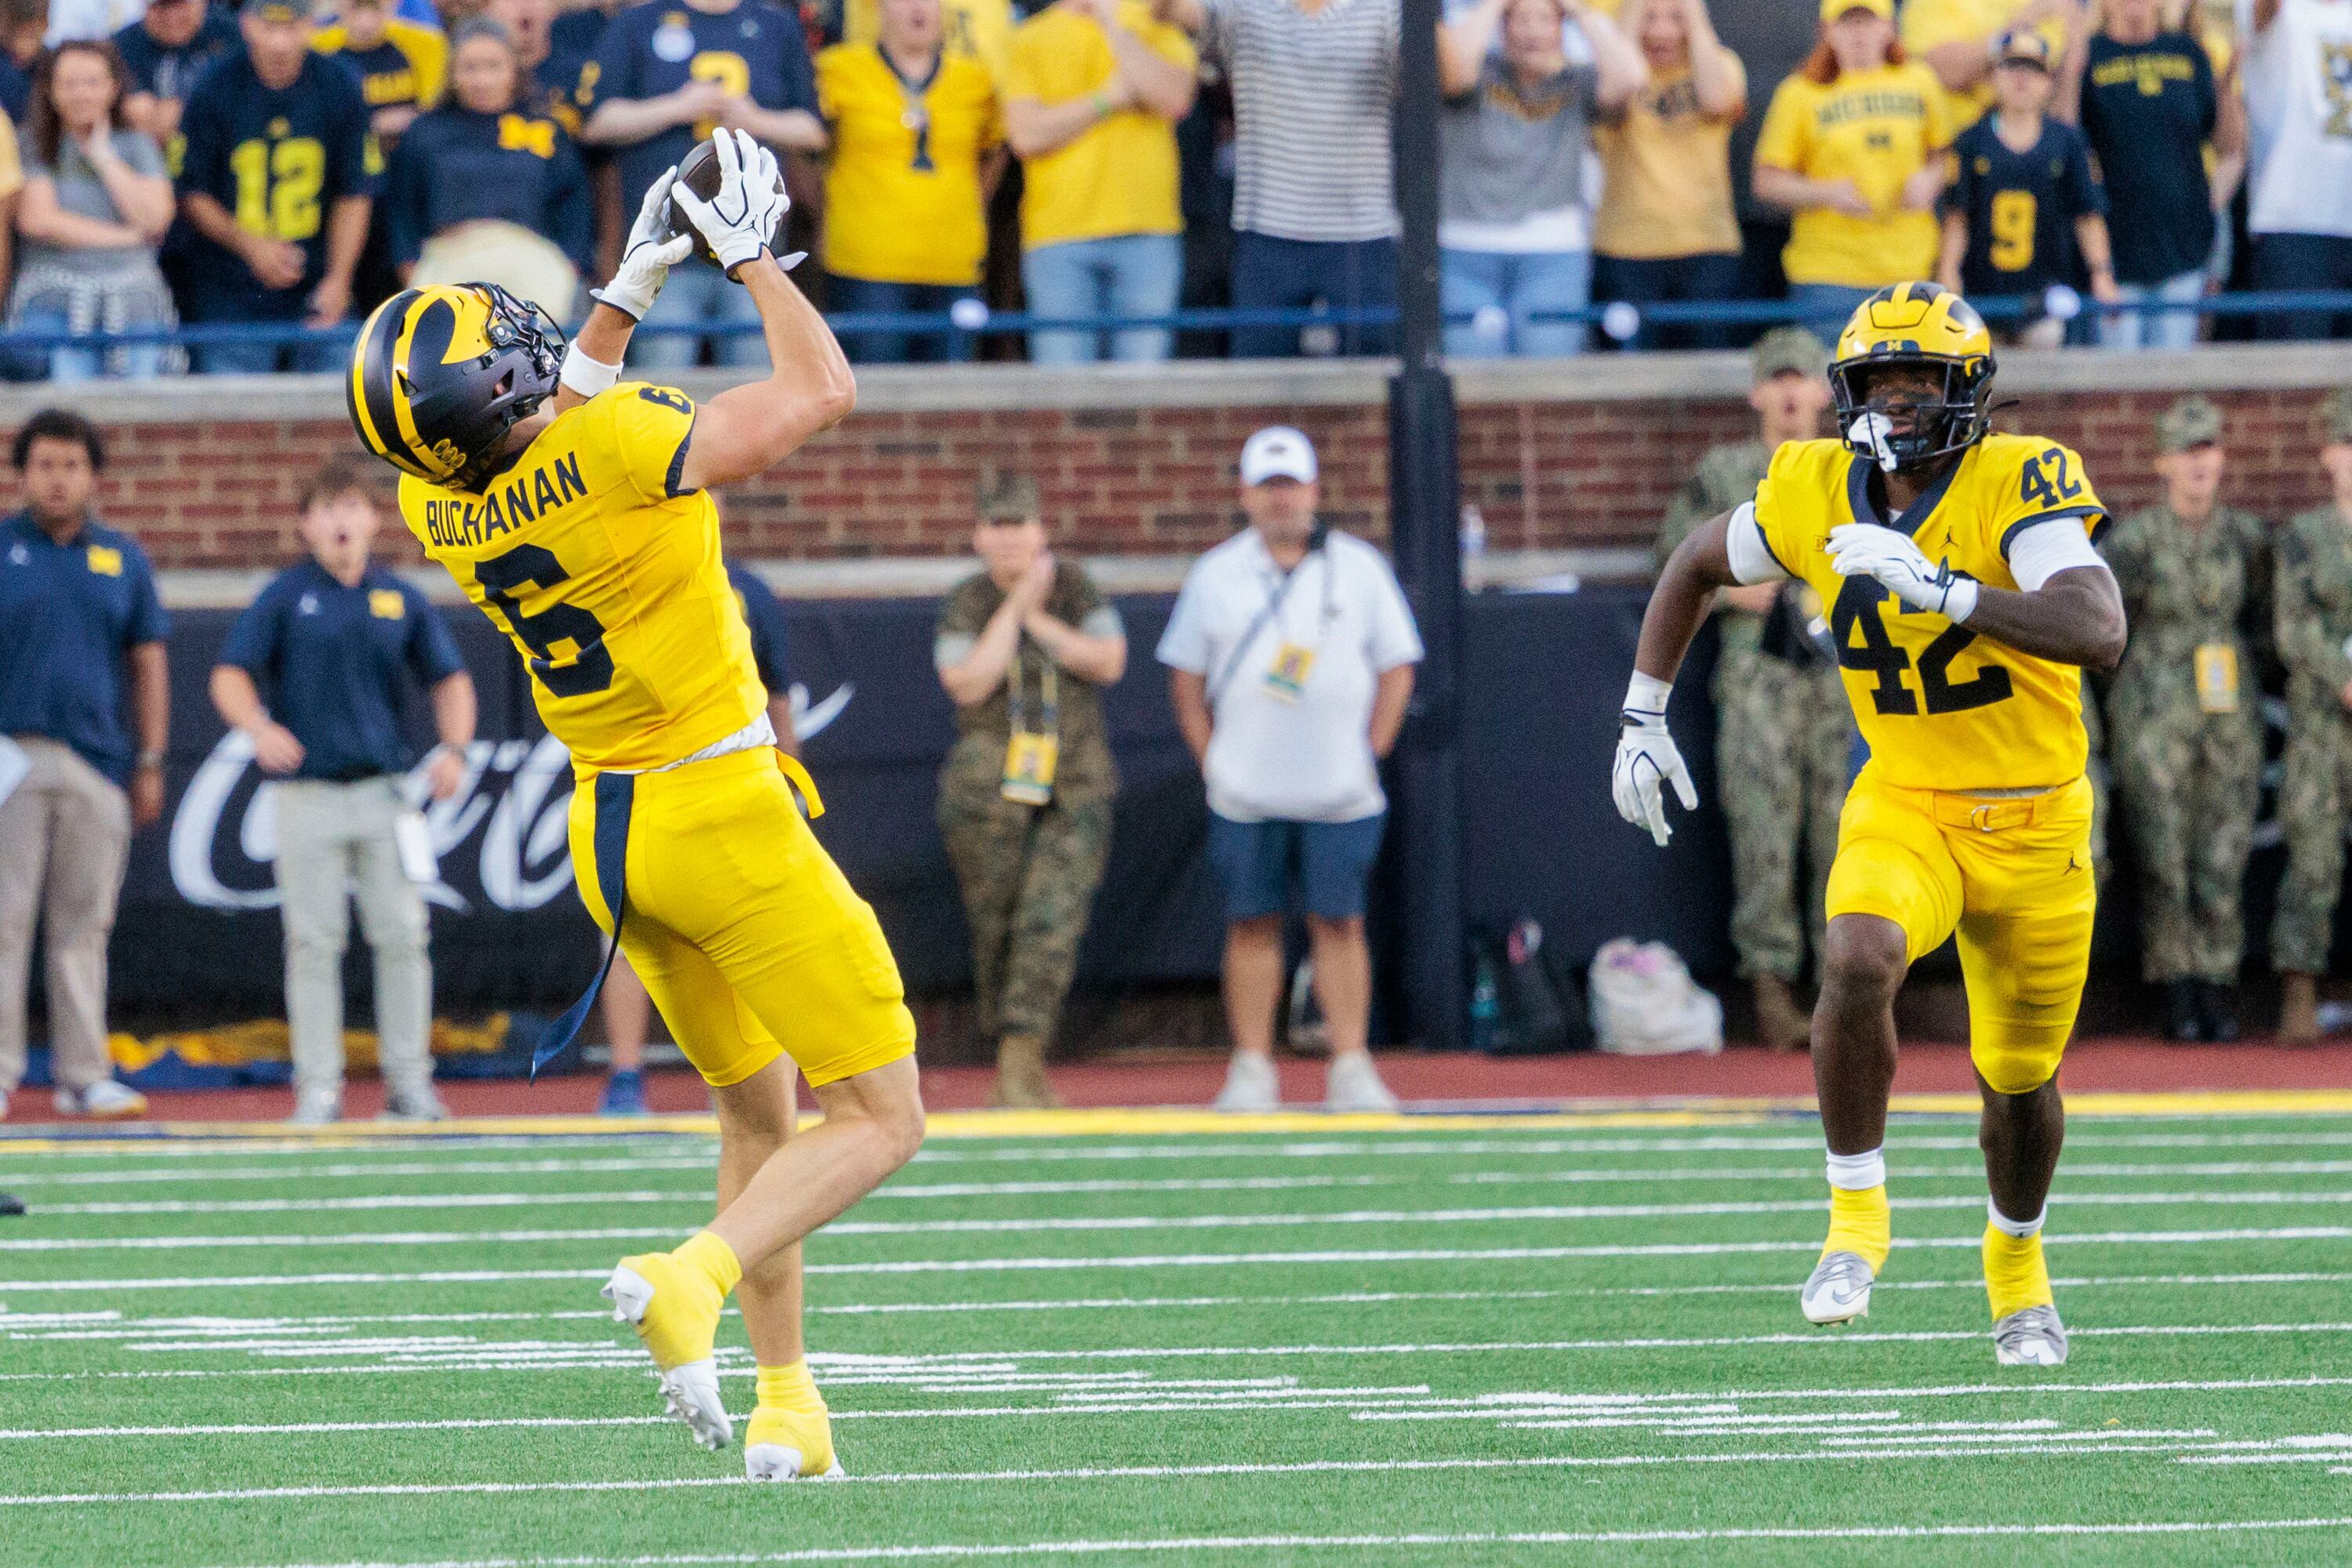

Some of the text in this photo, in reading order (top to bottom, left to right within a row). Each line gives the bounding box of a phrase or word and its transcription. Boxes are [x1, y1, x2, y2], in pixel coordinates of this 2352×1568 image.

[231, 136, 325, 240] 12
[1991, 189, 2036, 271] 9
[1886, 340, 1904, 351] M
[638, 387, 691, 415] 6
[426, 451, 588, 546] BUCHANAN
[2020, 448, 2082, 510] 42
[474, 543, 615, 698] 6
[1831, 570, 2013, 715] 42
